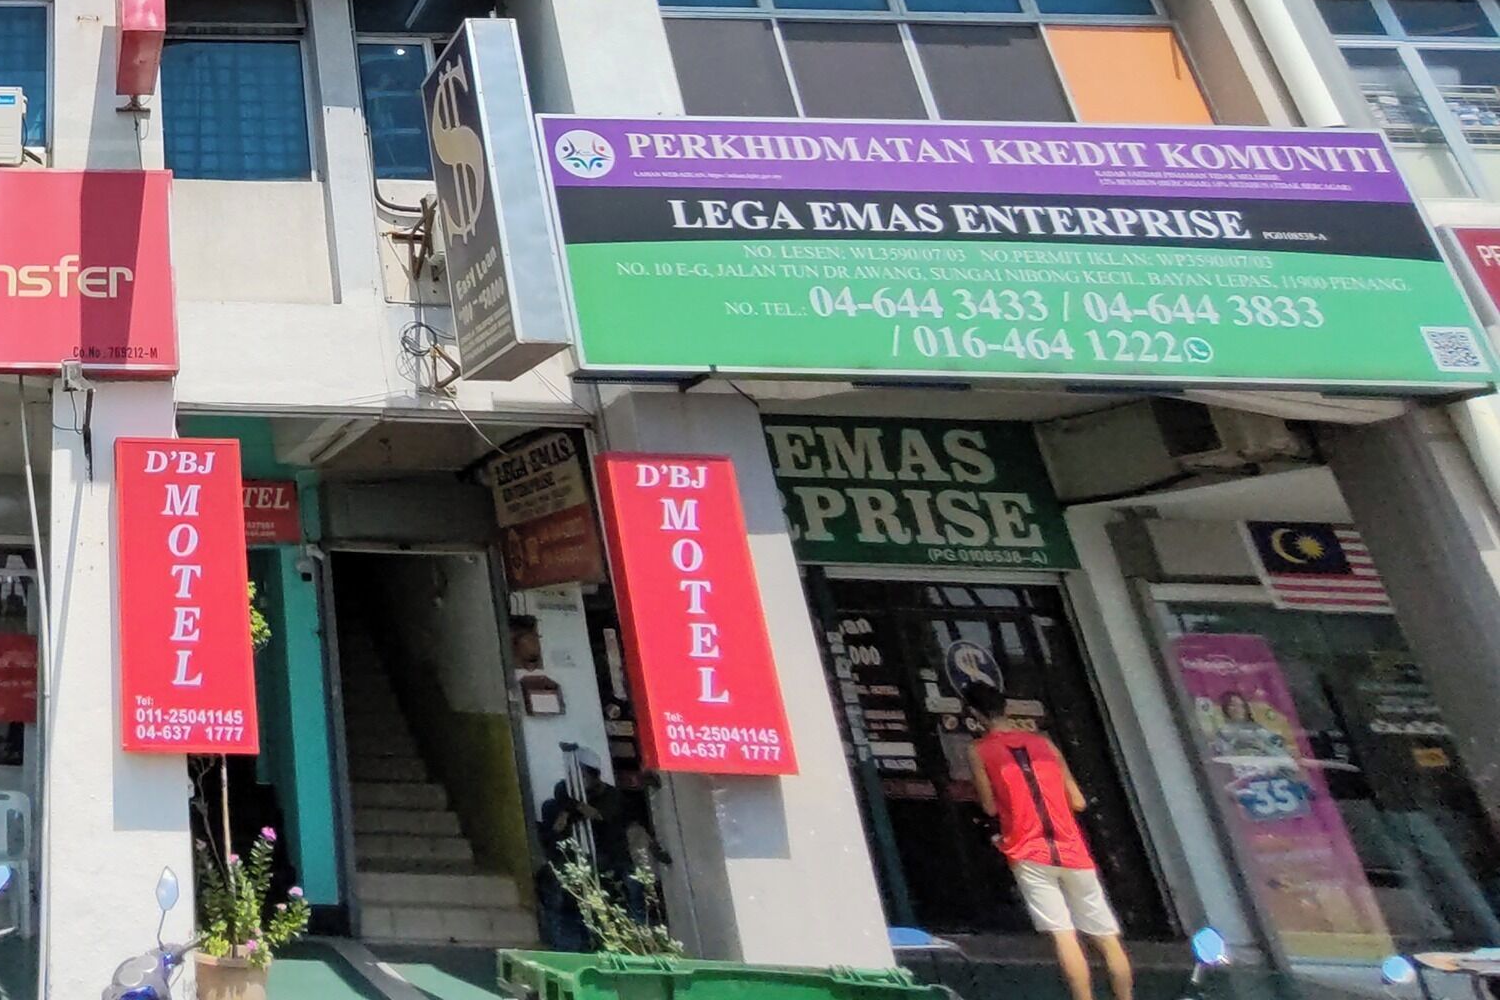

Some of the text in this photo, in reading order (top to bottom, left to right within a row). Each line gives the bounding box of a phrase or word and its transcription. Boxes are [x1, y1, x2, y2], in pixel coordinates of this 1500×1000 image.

[624, 131, 1391, 174] PERKHIDMATAN KREDIT KOMUNITI
[666, 199, 1252, 240] LEGA EMAS ENTERPRISE
[743, 244, 777, 259] NO.
[781, 244, 846, 261] LESEN:
[850, 246, 966, 262] WL3590/07/03
[1086, 251, 1152, 266] IKLAN:
[455, 266, 476, 301] Easy
[475, 246, 498, 281] Loan
[617, 262, 648, 275] NO.
[654, 262, 673, 276] 10
[714, 262, 777, 278] JALAN
[778, 264, 820, 279] TUN
[823, 265, 849, 279] DR
[930, 267, 1001, 283] SUNGAI
[1004, 268, 1079, 284] NIBONG
[1147, 272, 1215, 287] BAYAN
[725, 302, 759, 316] NO.
[809, 285, 945, 318] 04-644
[951, 287, 1049, 321] 3433
[1082, 290, 1220, 325] 04-644
[1226, 294, 1325, 328] 3833
[913, 325, 1184, 363] 016-464 1222
[143, 450, 216, 474] D'BJ
[764, 425, 998, 485] EMAS
[635, 463, 709, 489] D'BJ
[788, 486, 1046, 548] PRISE
[160, 483, 203, 686] MOTEL
[658, 498, 730, 704] MOTEL
[135, 695, 154, 707] Tel:
[135, 709, 244, 725] 011-25041145
[663, 711, 684, 723] Tel:
[135, 725, 245, 742] 04-637 1777
[666, 724, 779, 744] 011-25041145
[669, 741, 781, 761] 04-637 1777
